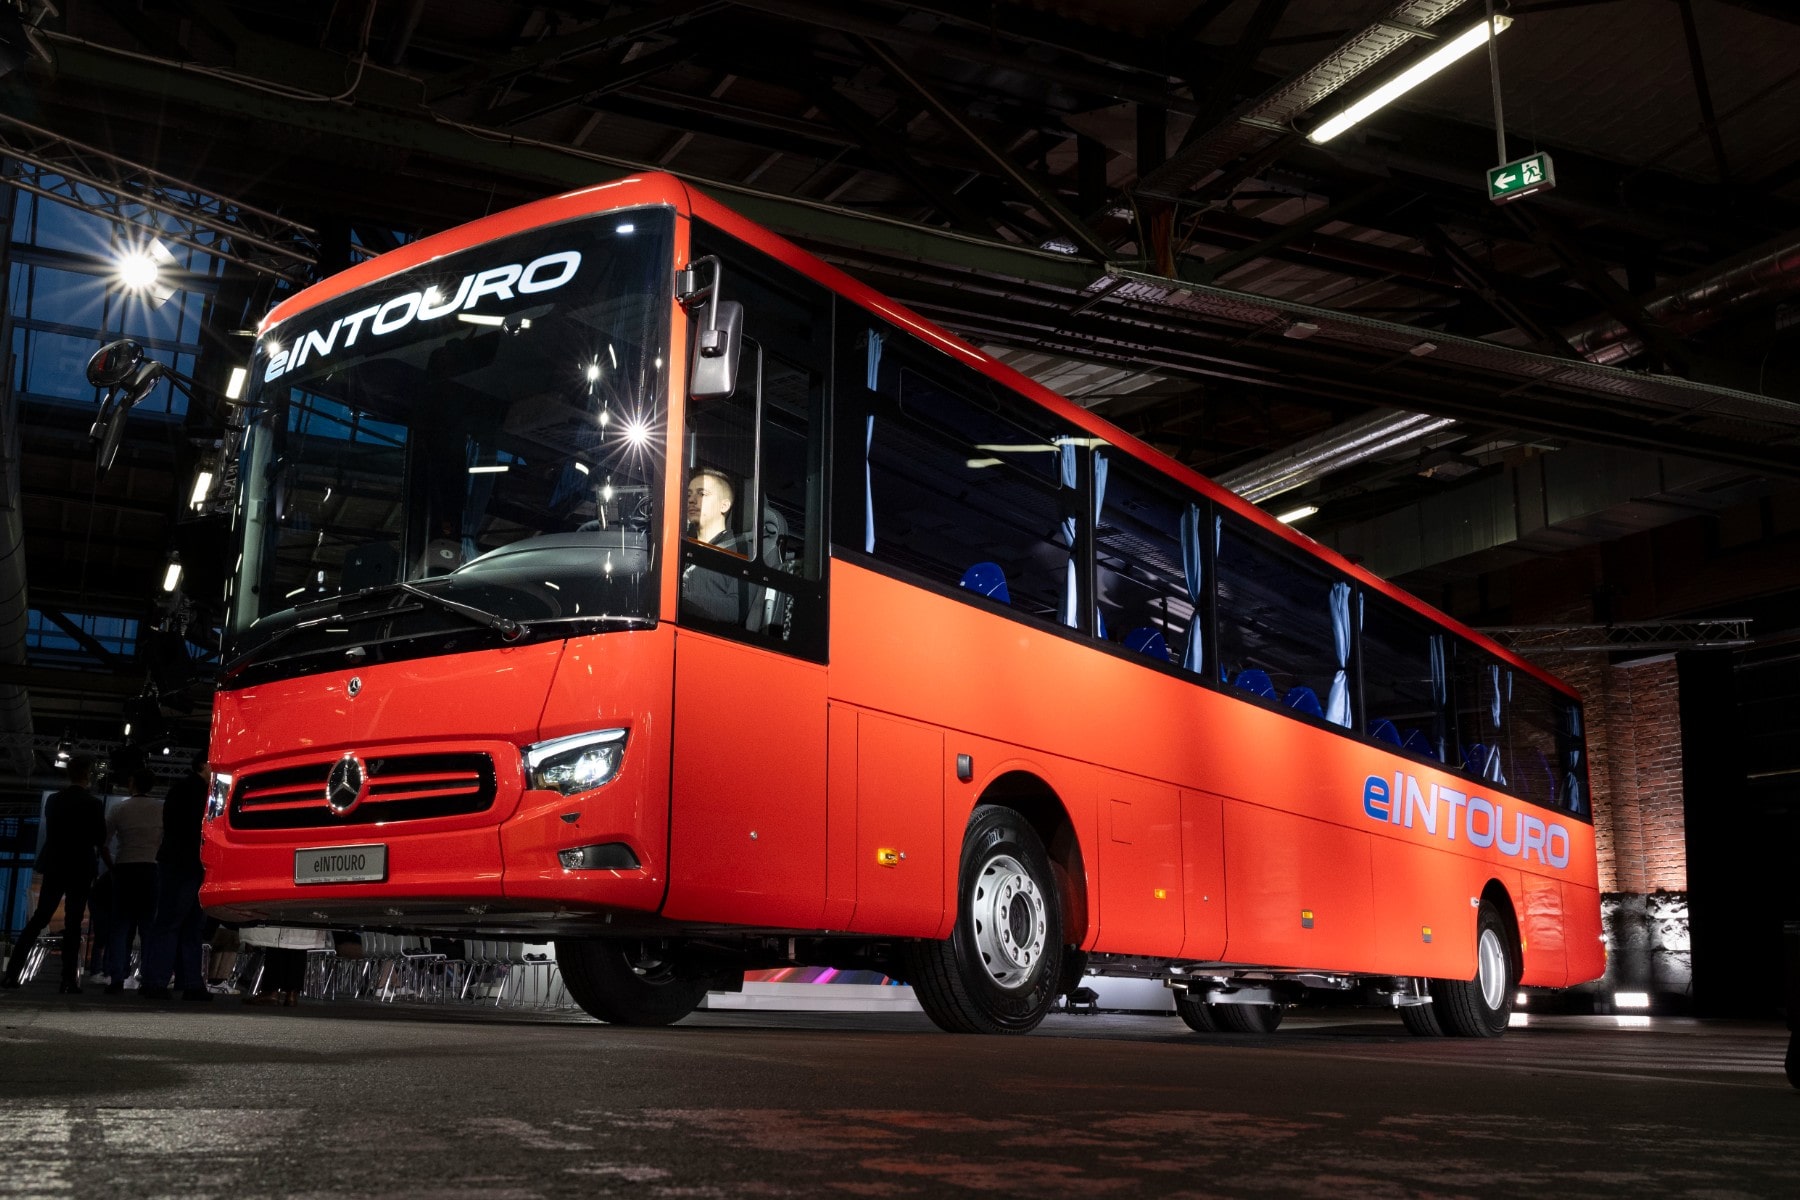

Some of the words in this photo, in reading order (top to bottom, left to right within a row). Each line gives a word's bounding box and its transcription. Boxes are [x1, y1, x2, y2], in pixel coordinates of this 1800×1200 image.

[264, 251, 582, 383] eINTOURO
[314, 854, 366, 872] eINTOURO
[1363, 771, 1569, 869] eINTOURO
